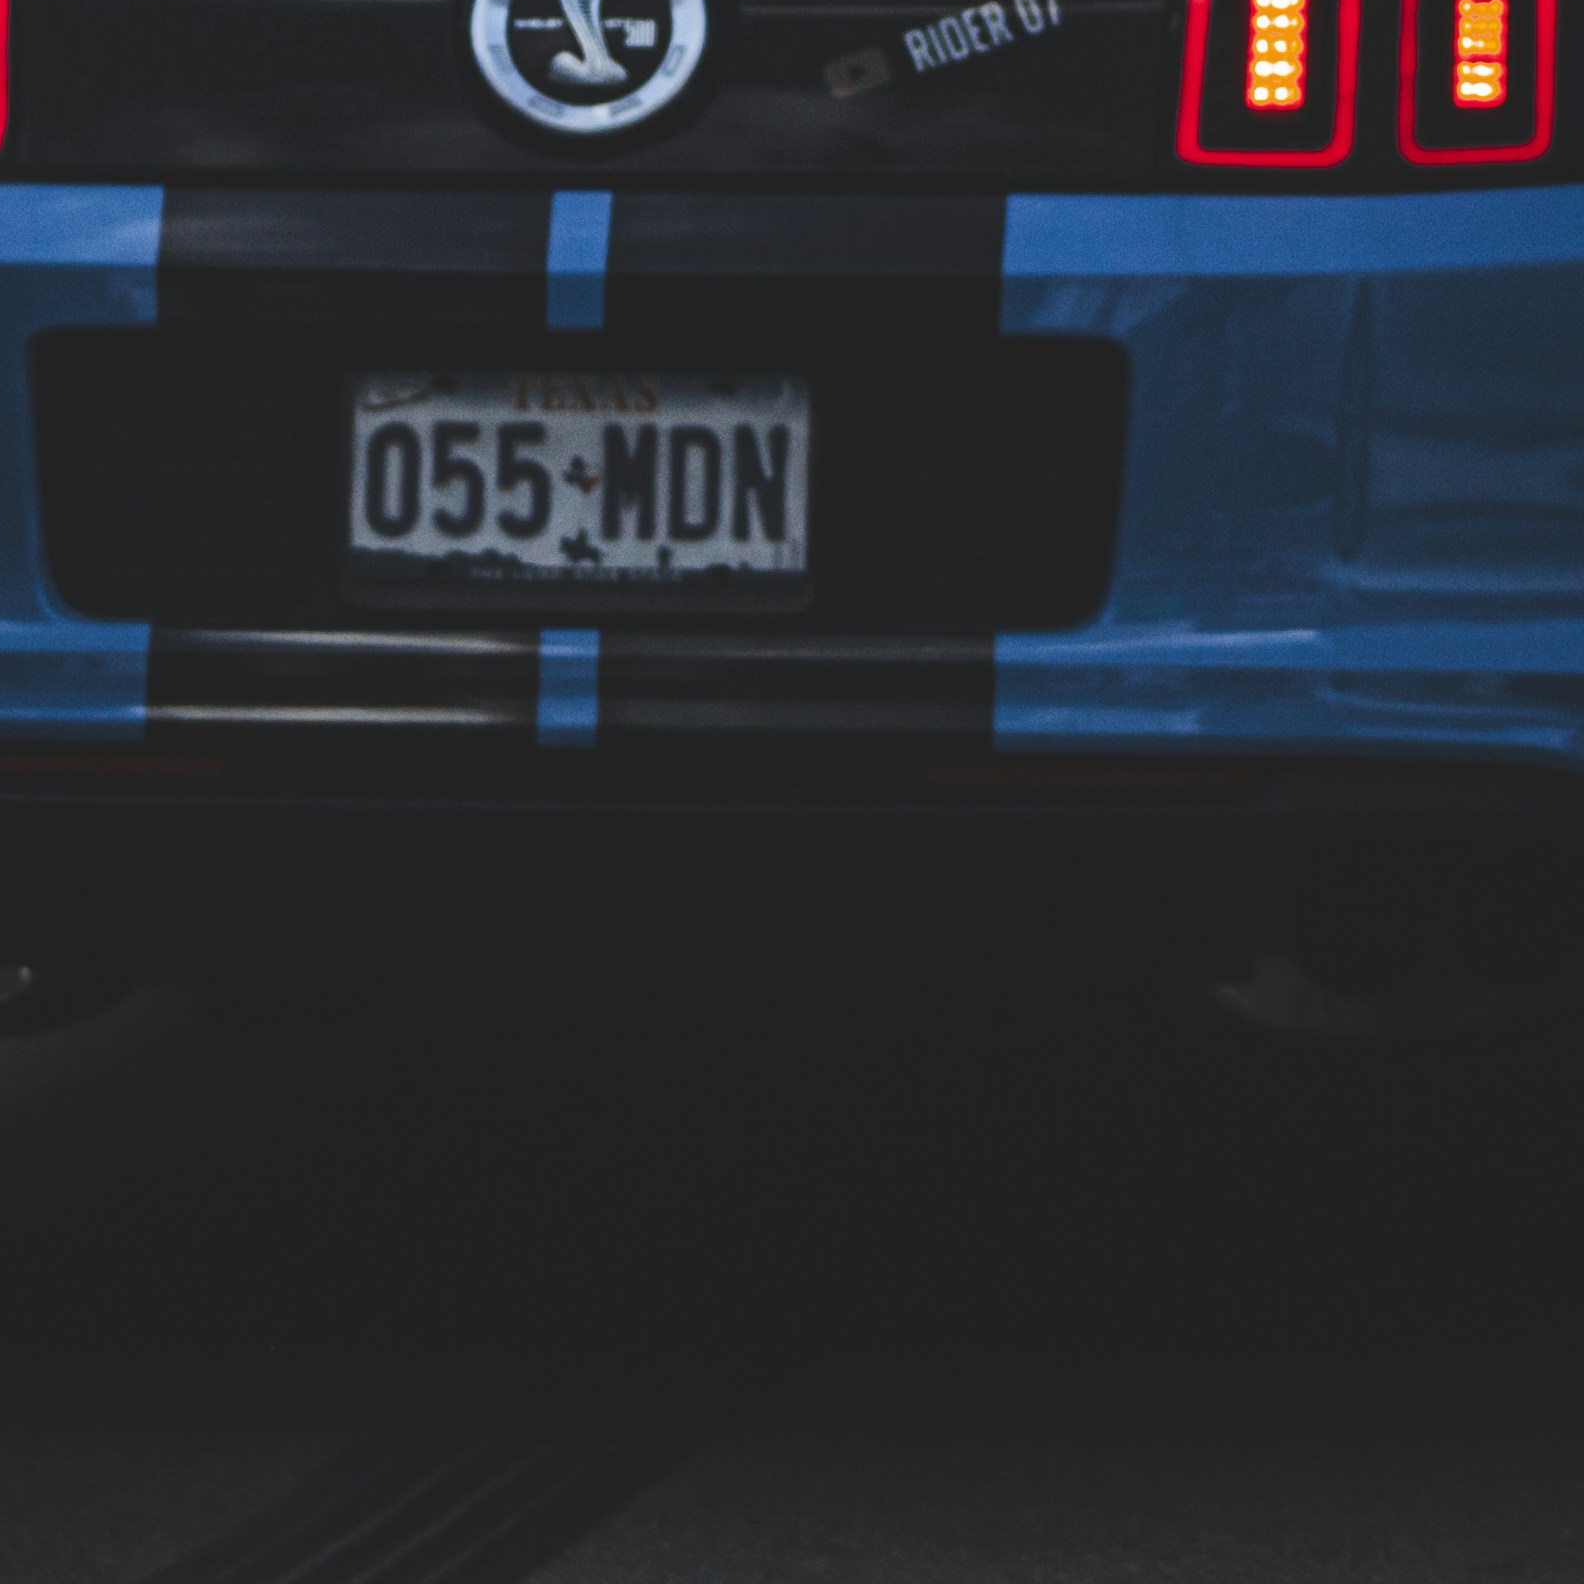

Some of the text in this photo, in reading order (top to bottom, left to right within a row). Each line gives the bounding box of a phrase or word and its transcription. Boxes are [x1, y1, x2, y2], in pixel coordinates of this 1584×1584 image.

[902, 0, 1016, 74] RIDER
[510, 372, 662, 414] TEXAS
[365, 419, 789, 542] 055 MDN
